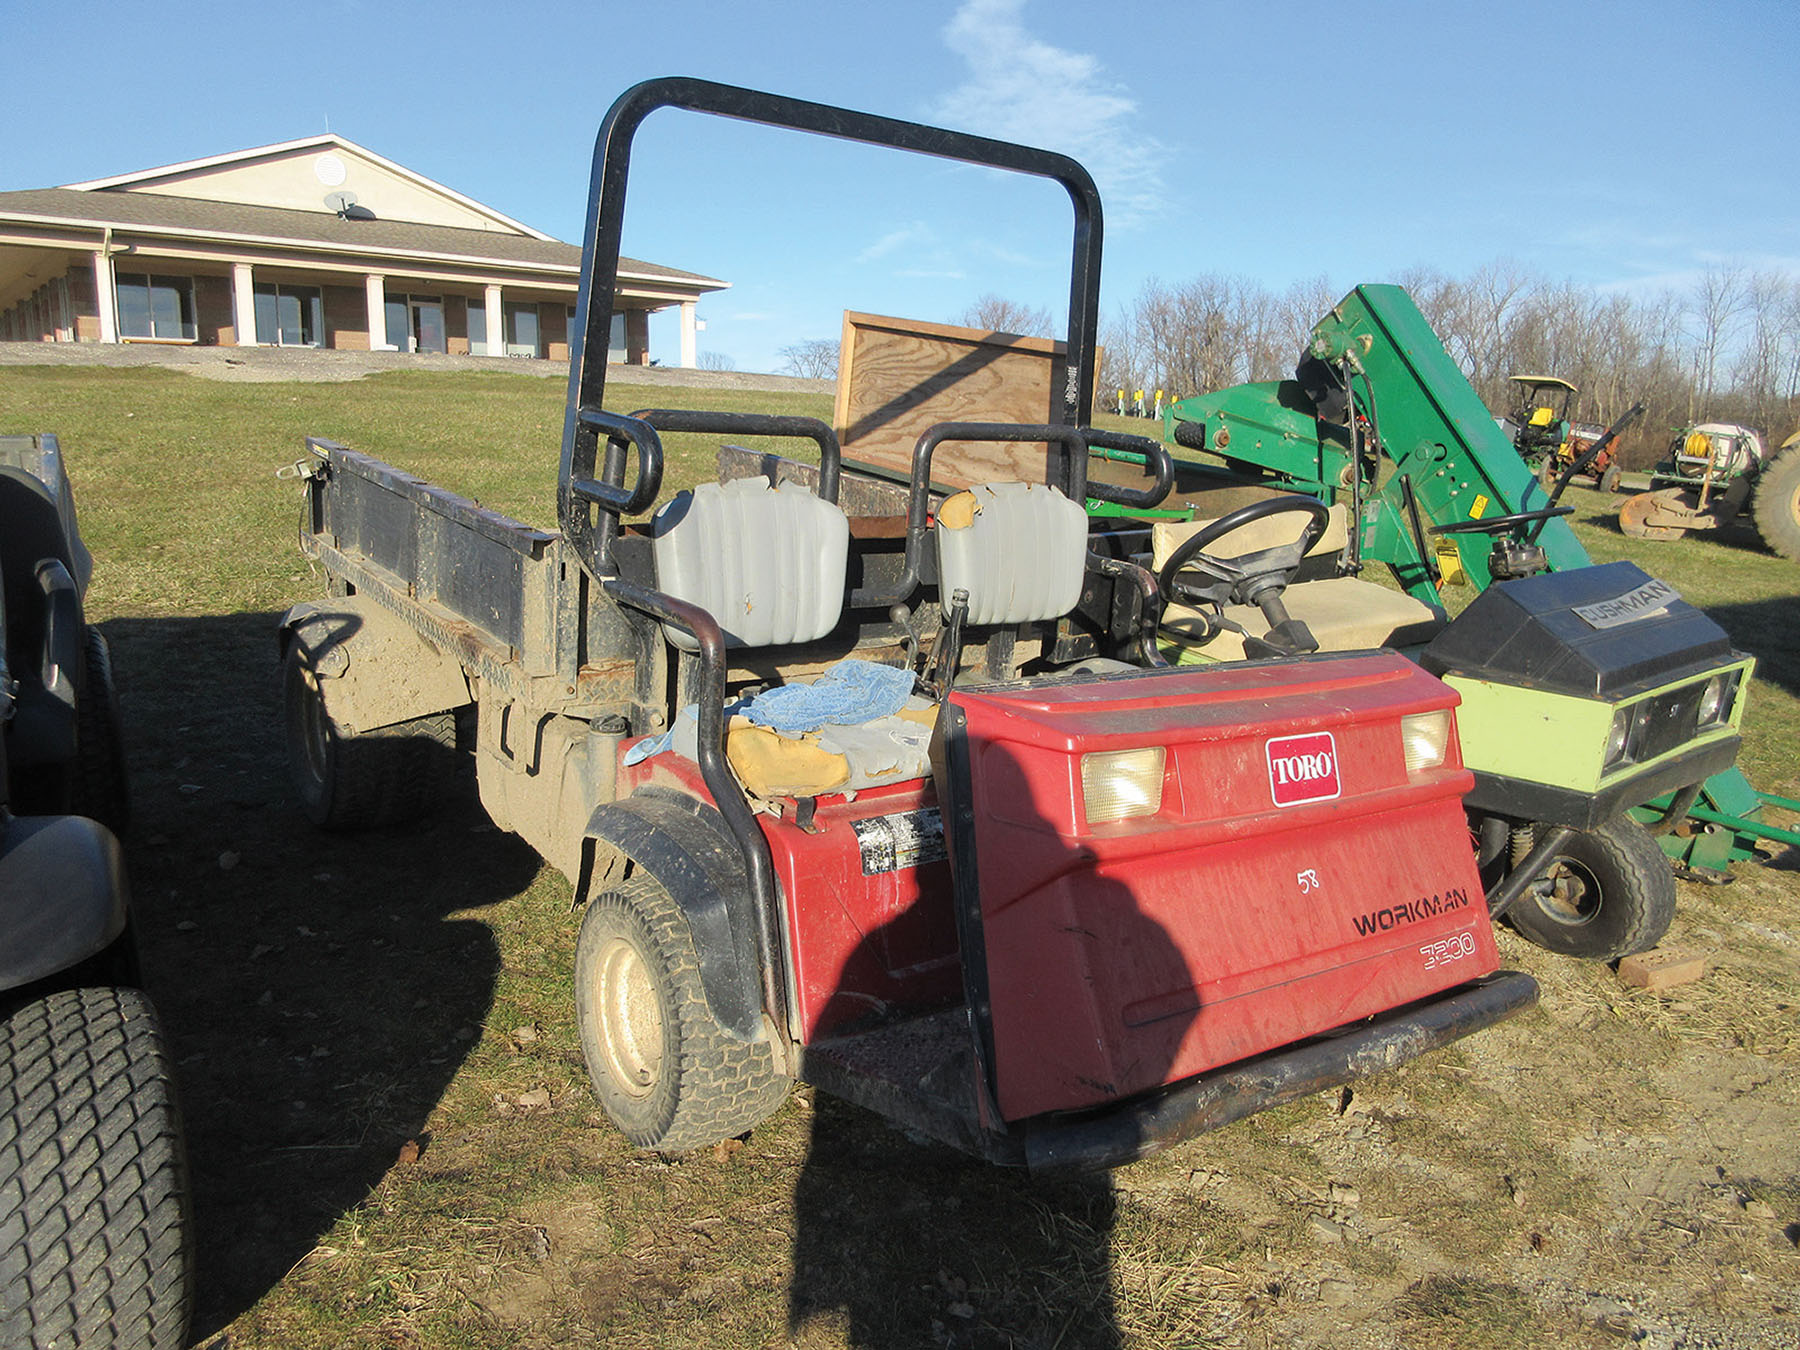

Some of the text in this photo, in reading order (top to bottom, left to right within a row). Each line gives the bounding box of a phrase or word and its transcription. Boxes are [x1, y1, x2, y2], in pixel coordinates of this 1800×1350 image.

[1580, 581, 1671, 621] CUSHMAN
[1272, 751, 1332, 785] TORO
[1297, 868, 1320, 894] 58
[1352, 888, 1468, 936] WORKMAN
